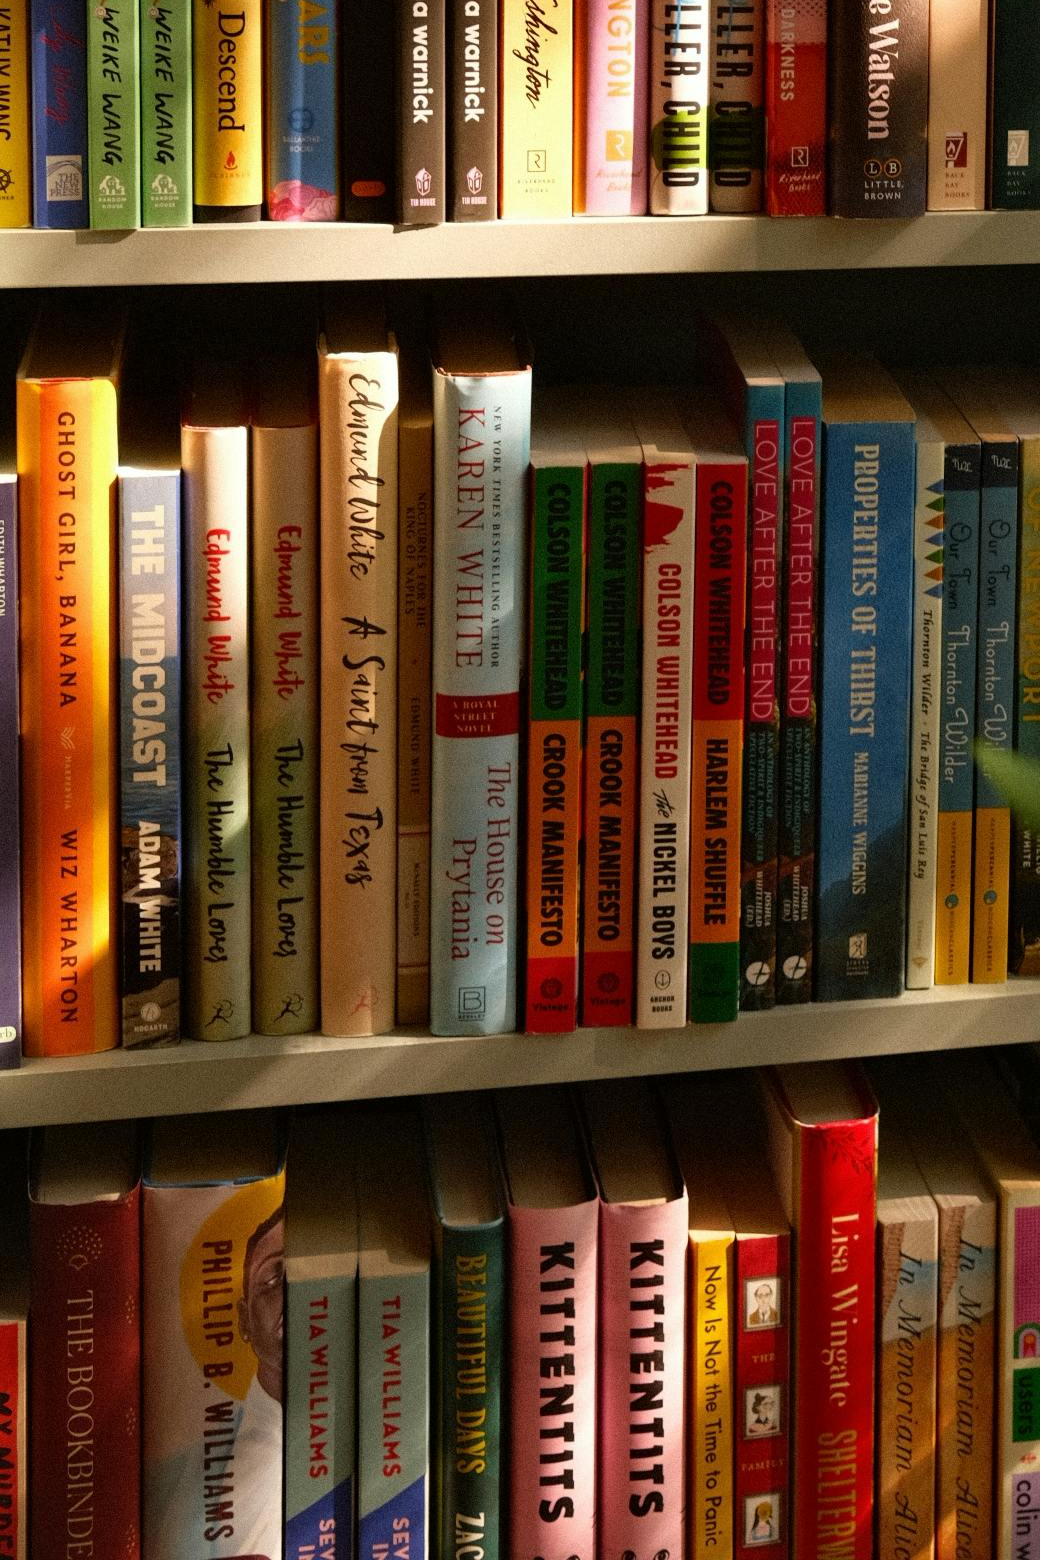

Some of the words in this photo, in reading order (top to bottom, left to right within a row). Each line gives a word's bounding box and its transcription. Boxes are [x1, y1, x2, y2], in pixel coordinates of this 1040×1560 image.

[218, 11, 246, 132] Descend
[411, 25, 432, 123] warnick
[868, 19, 899, 140] Watson
[662, 101, 699, 187] CHILD
[864, 192, 902, 200] BROWN
[492, 406, 501, 430] NEW
[57, 411, 76, 498] GHOST
[457, 406, 485, 530] KAREN
[492, 439, 501, 473] YORK
[492, 479, 501, 518] TIMES
[55, 513, 76, 581] GIRL,
[131, 505, 165, 578] THE
[491, 524, 500, 611] BESTSELLING
[457, 551, 485, 667] WHITE
[658, 563, 683, 648] COLSON
[59, 595, 78, 707] BANANA
[491, 617, 500, 667] AUTHOR
[921, 610, 933, 669] Thornton
[131, 592, 166, 786] MIDCOAST
[655, 656, 681, 778] WHITEHEAD
[921, 674, 932, 715] Wilder
[920, 732, 929, 752] The
[487, 762, 511, 808] The
[916, 794, 929, 805] of
[918, 756, 929, 790] Bridge
[653, 789, 674, 817] The
[918, 808, 928, 826] San
[60, 831, 80, 879] WIZ
[137, 820, 162, 893] ADAM
[486, 818, 511, 904] House
[654, 822, 676, 898] NICKEL
[915, 857, 926, 879] Rey
[917, 831, 928, 852] Luis
[448, 838, 475, 960] Prytania
[59, 892, 79, 1023] WHARTON
[140, 897, 161, 972] WHITE
[487, 914, 504, 946] on
[652, 906, 674, 959] BOYS
[830, 1213, 859, 1274] Lisa
[202, 1240, 234, 1346] PHILLIP
[704, 1265, 722, 1310] Now
[383, 1296, 401, 1339] TIA
[704, 1319, 722, 1332] Is
[822, 1284, 859, 1407] Wingate
[204, 1363, 232, 1388] B.
[630, 1239, 664, 1517] KITTENTITS
[704, 1341, 722, 1376] Not
[383, 1345, 401, 1477] WILLIAMS
[704, 1385, 722, 1412] the
[704, 1418, 722, 1462] Time
[203, 1402, 234, 1541] WILLIAMS
[704, 1471, 720, 1489] to
[704, 1498, 722, 1546] Panic
